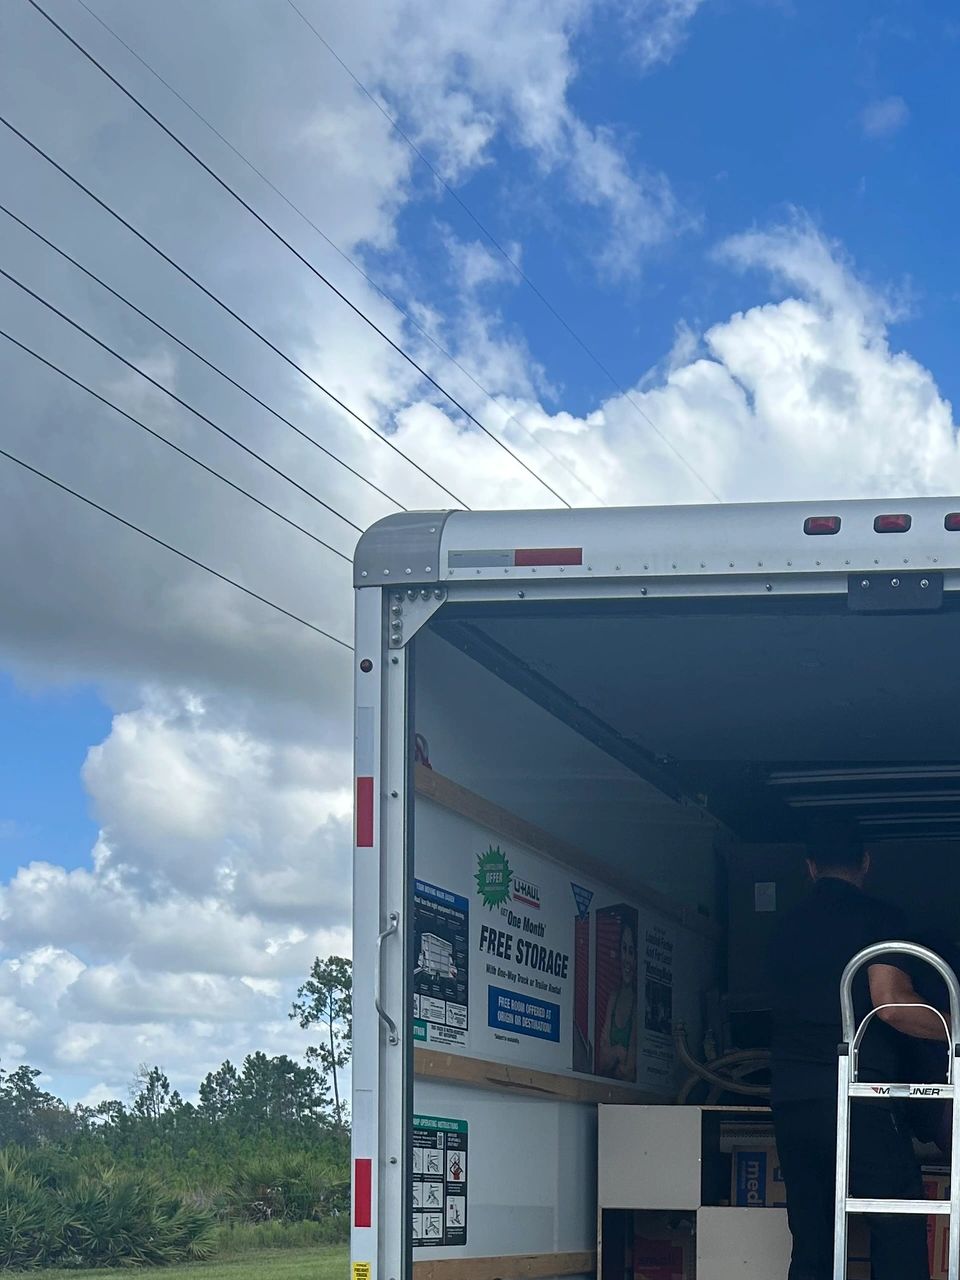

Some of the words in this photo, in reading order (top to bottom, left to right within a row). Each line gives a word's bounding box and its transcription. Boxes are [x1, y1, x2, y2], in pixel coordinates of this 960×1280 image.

[486, 872, 503, 883] OFFER
[508, 911, 521, 928] One
[479, 925, 513, 961] FREE
[515, 938, 569, 979] STORAGE
[498, 996, 511, 1009] FREE
[878, 1087, 941, 1096] MINER
[747, 1160, 764, 1206] med
